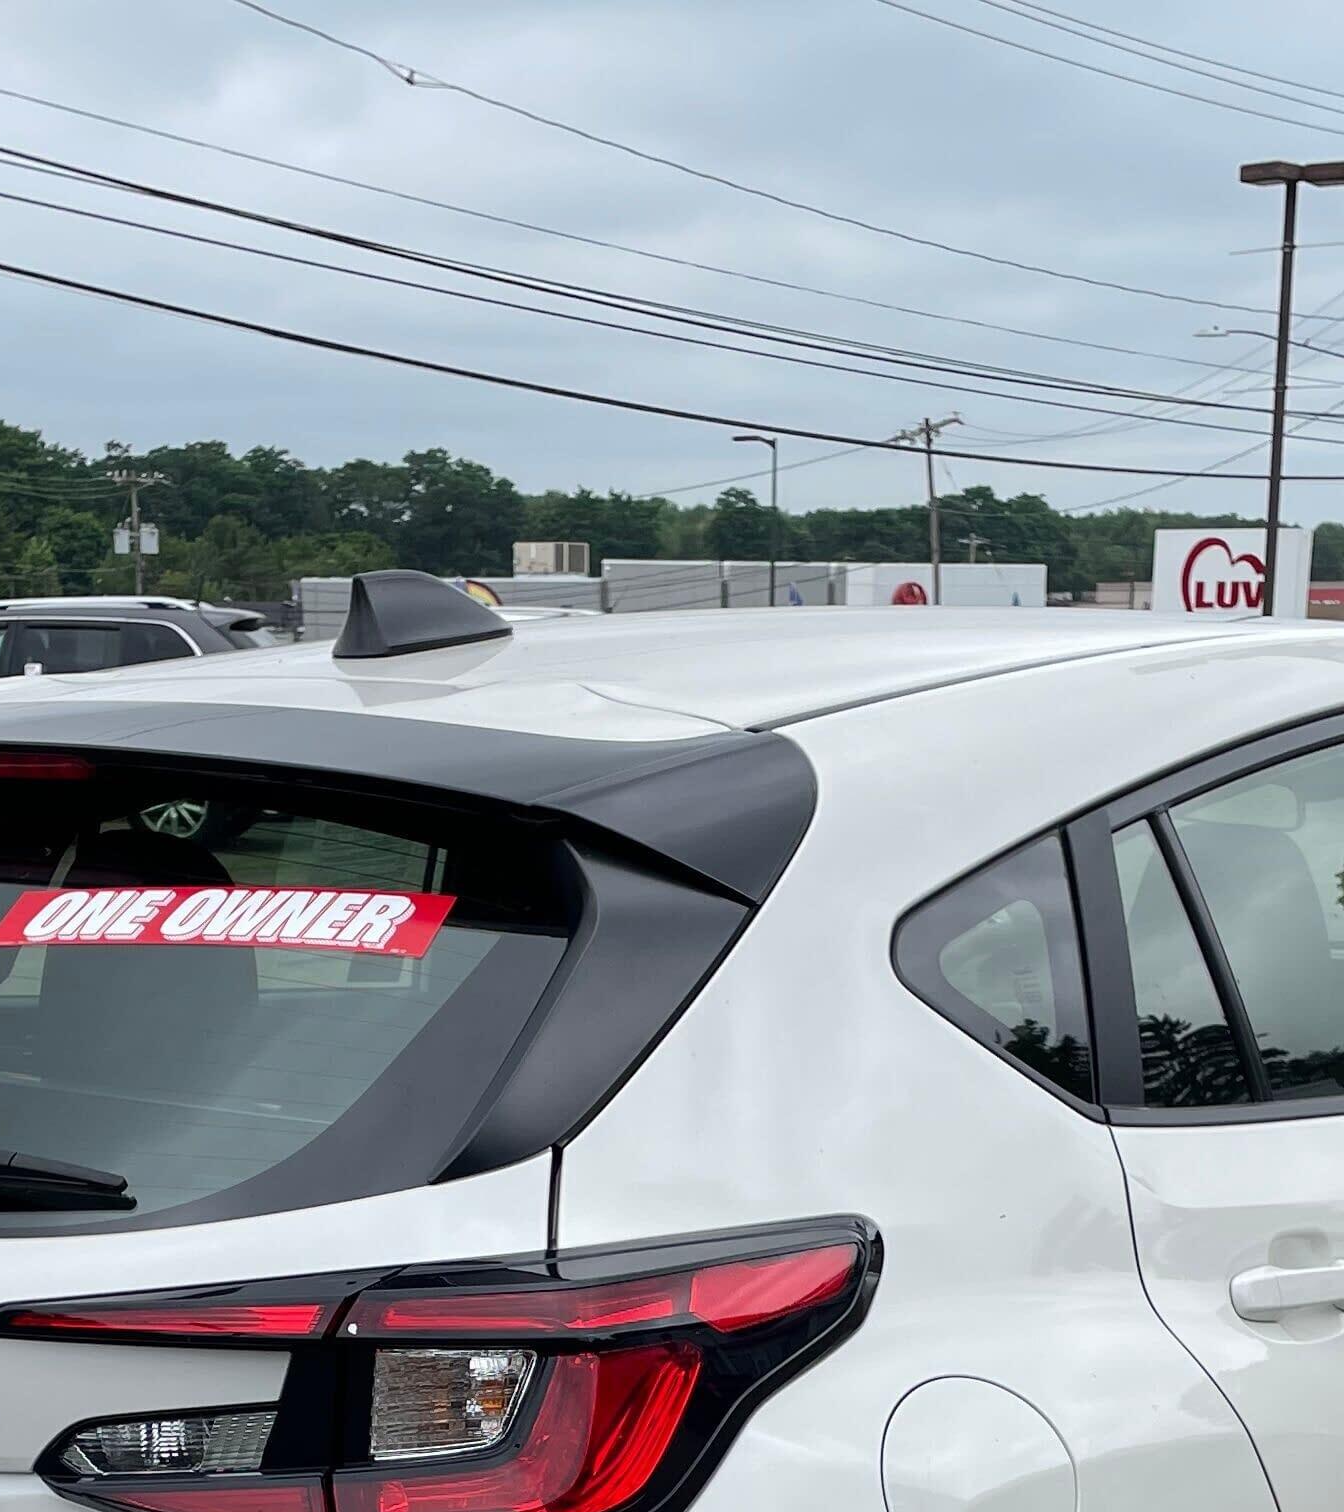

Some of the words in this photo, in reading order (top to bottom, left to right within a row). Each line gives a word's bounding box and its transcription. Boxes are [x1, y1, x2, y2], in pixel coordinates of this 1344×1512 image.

[1195, 581, 1265, 608] LUV
[24, 890, 176, 942] ONE
[160, 889, 417, 949] OWNER
